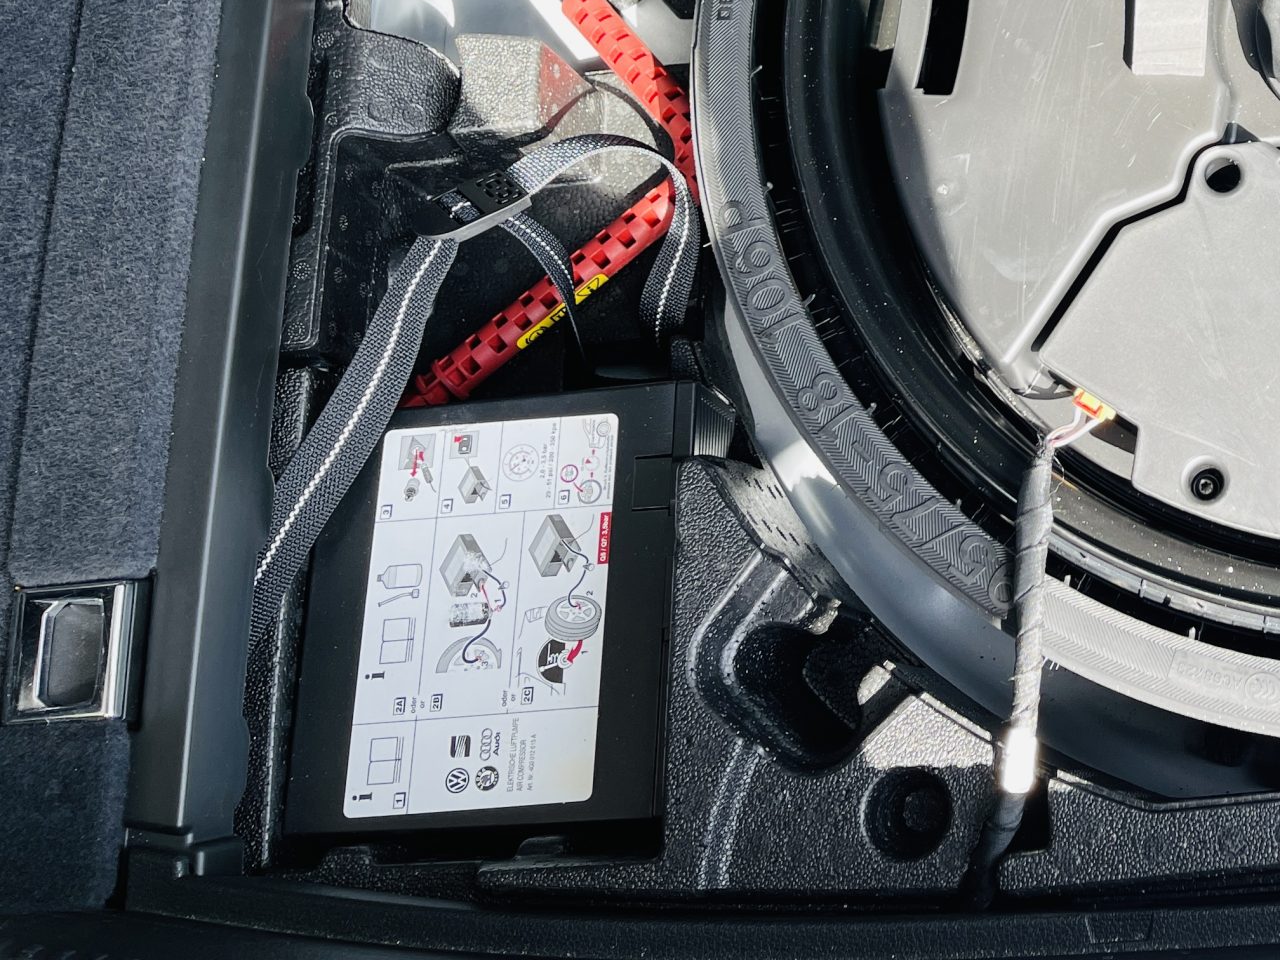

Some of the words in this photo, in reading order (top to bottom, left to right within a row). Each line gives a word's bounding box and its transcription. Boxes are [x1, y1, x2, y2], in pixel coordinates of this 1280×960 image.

[720, 200, 803, 347] 106P
[797, 371, 1016, 612] 95/75-18
[493, 732, 501, 756] Audi
[510, 717, 519, 751] LUFTPUMPE
[507, 753, 516, 792] ELEKTRISCHE
[517, 739, 526, 780] COMPRESSOR
